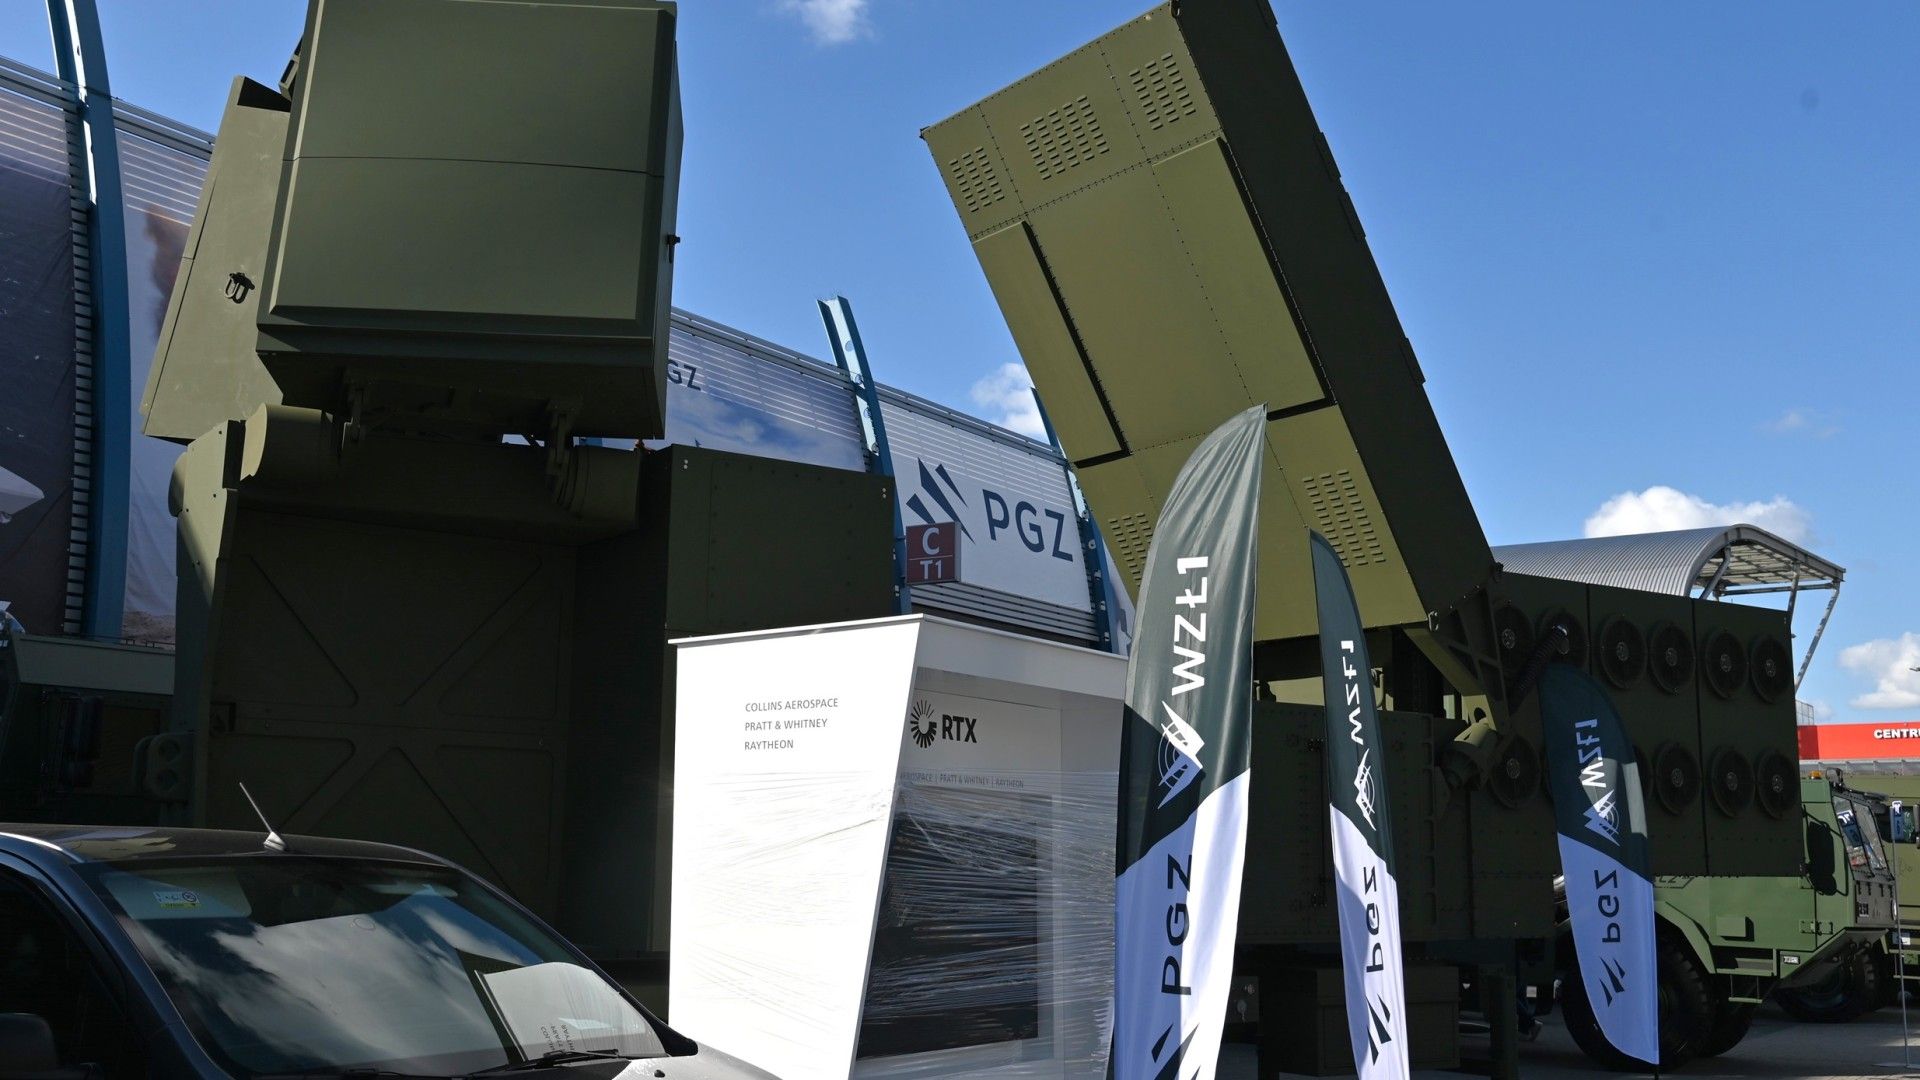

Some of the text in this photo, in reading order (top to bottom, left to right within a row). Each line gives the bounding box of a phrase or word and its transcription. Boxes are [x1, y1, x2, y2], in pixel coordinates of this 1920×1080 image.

[667, 359, 701, 391] GZ
[982, 489, 1073, 562] PGZ
[922, 527, 940, 556] C
[920, 559, 942, 580] T1
[1171, 556, 1210, 696] WZŁ1
[745, 698, 839, 713] COLLINS AEROSPACE
[745, 718, 829, 731] PRATT & WHITNEY
[942, 714, 978, 744] RTX
[1873, 728, 1920, 739] CENTR
[744, 739, 794, 751] RAYTHEON
[1161, 853, 1193, 996] PGZ
